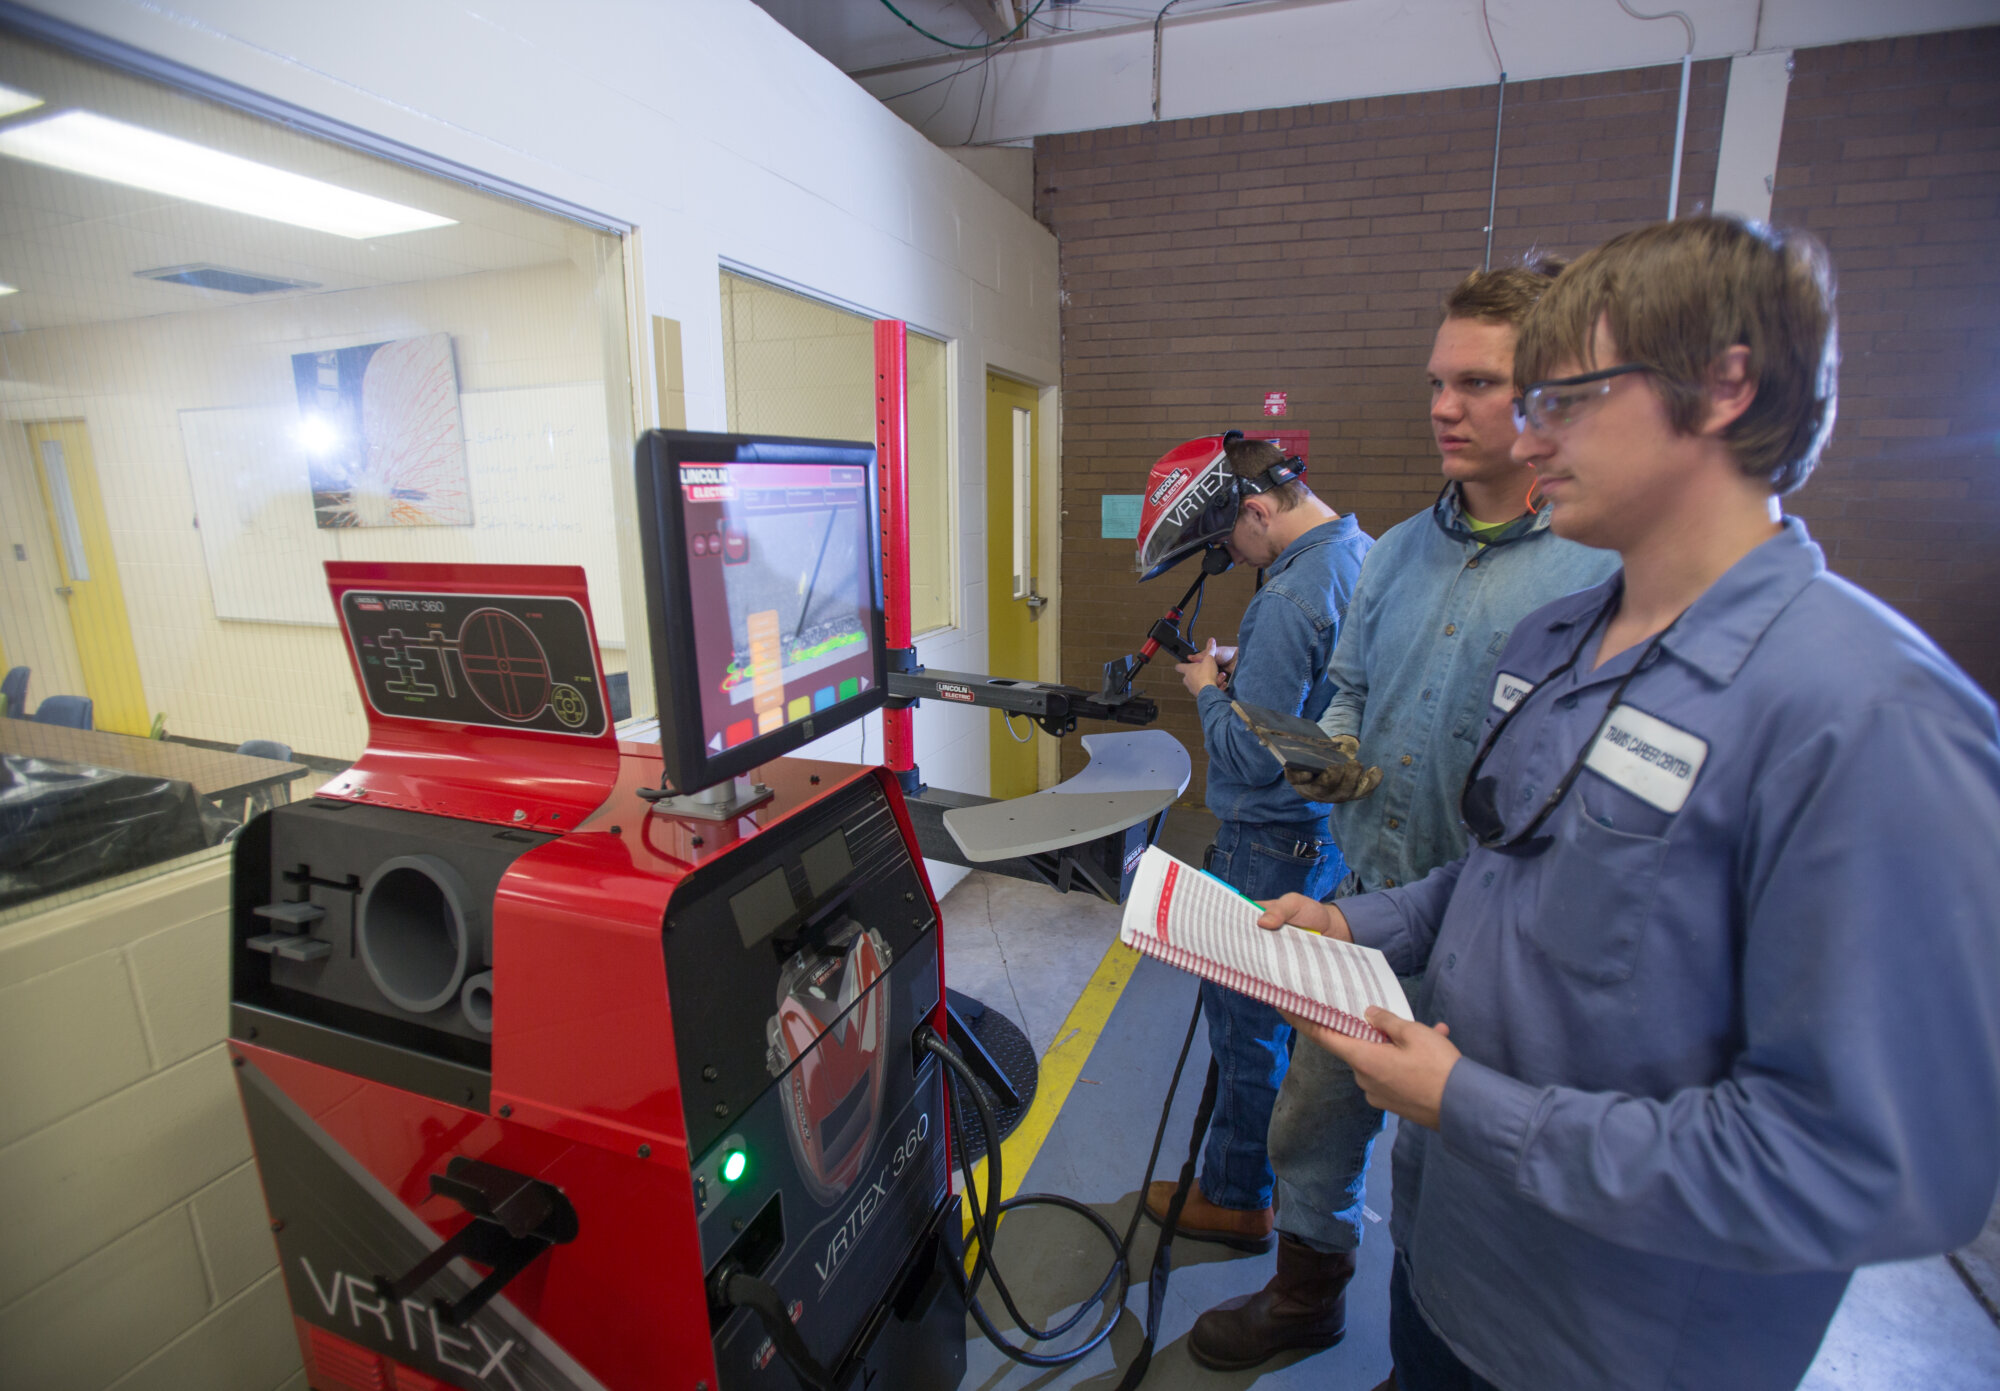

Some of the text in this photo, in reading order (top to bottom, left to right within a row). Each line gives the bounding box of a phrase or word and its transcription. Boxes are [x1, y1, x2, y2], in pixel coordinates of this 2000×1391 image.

[680, 468, 728, 485] LINCOLN
[1151, 471, 1180, 503] LINCOLN
[1162, 474, 1188, 502] ELECTRIC
[1166, 462, 1233, 526] VRTEX
[384, 600, 420, 611] VRTEX
[421, 601, 445, 612] 360
[939, 684, 968, 693] LINCOLN
[944, 691, 971, 700] ELECTRIC
[1605, 726, 1691, 780] TRAVIS CAREER CENTER
[815, 1112, 929, 1281] VRTEX 360
[300, 1256, 523, 1391] VRTEX
